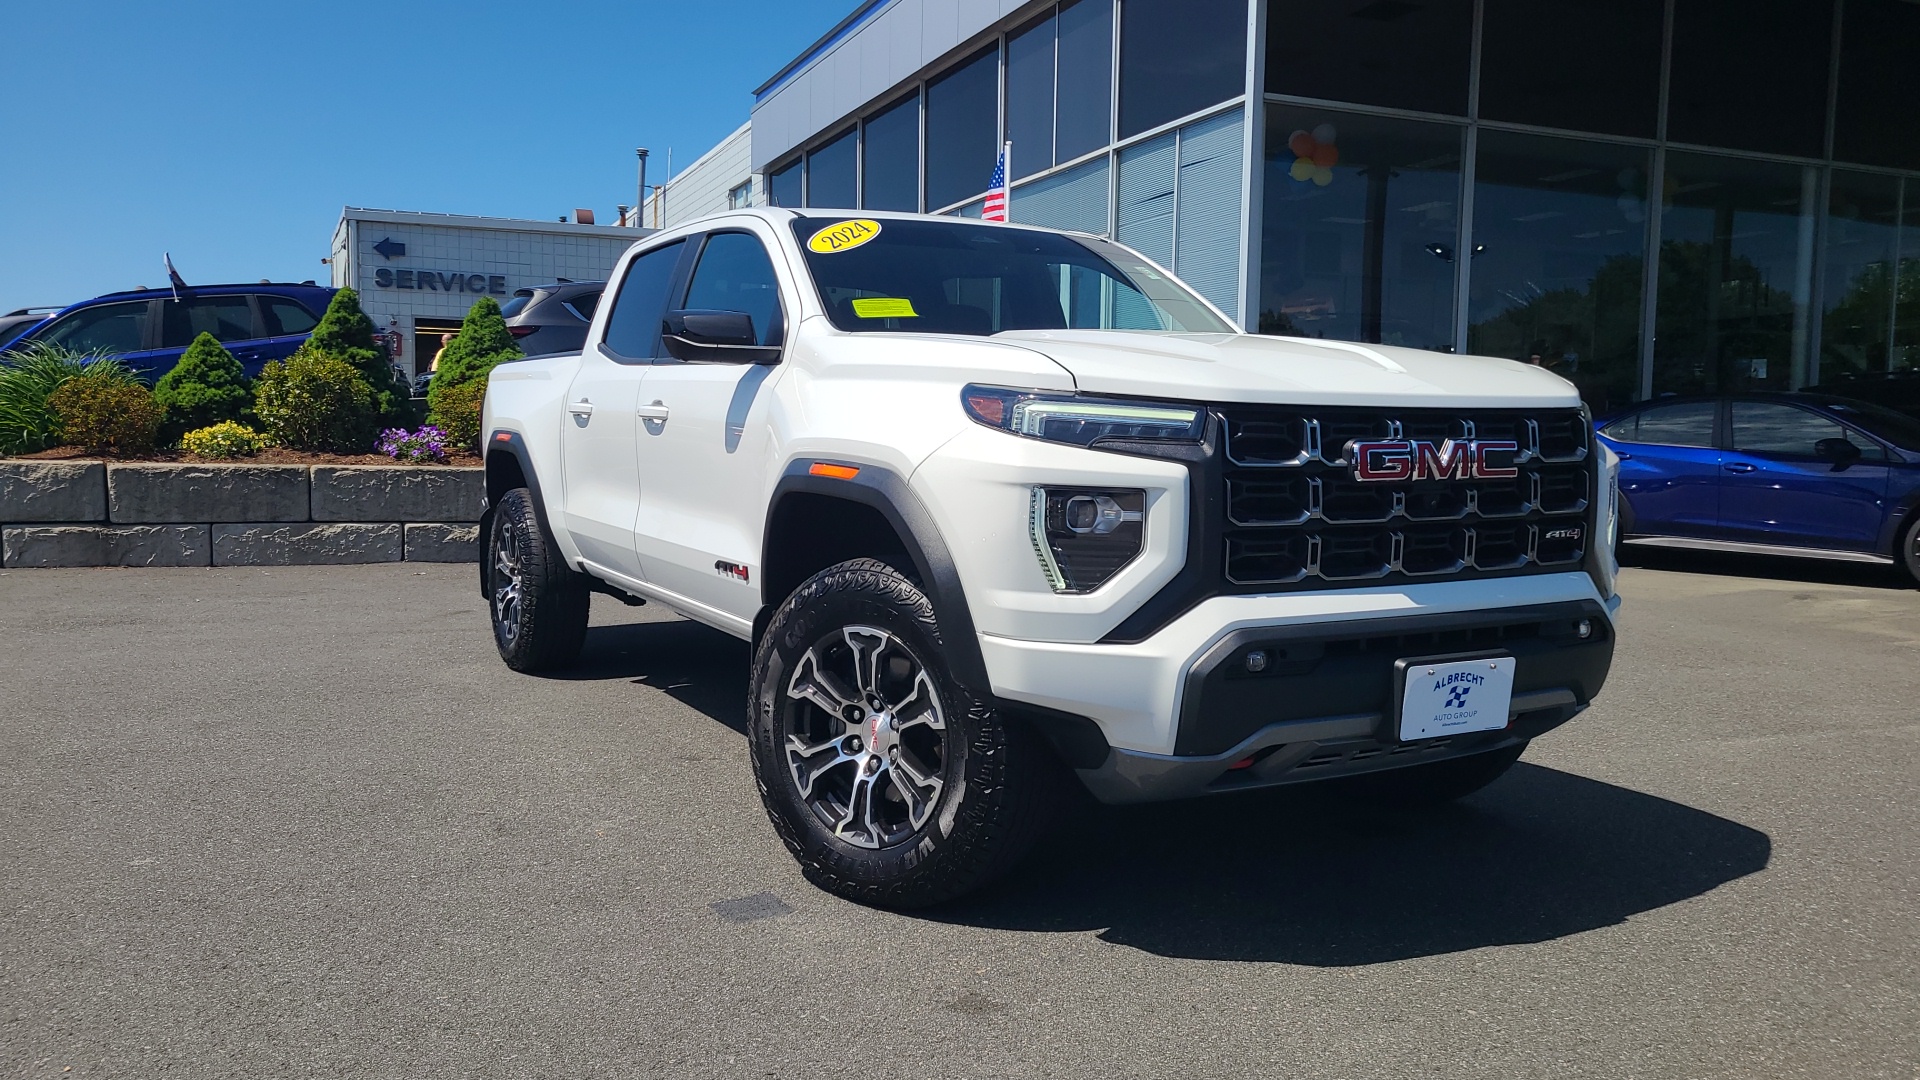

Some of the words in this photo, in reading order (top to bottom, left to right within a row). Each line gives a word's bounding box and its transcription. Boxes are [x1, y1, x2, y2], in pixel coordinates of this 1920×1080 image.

[821, 222, 872, 249] 2024
[375, 268, 506, 294] SERVICE
[1353, 439, 1518, 481] GMC
[1545, 529, 1580, 539] AT4
[714, 560, 749, 582] AT4
[1433, 672, 1485, 692] ALBRECHT
[1433, 712, 1452, 721] AUTO
[1454, 710, 1478, 719] GROUP
[871, 719, 879, 751] GMC
